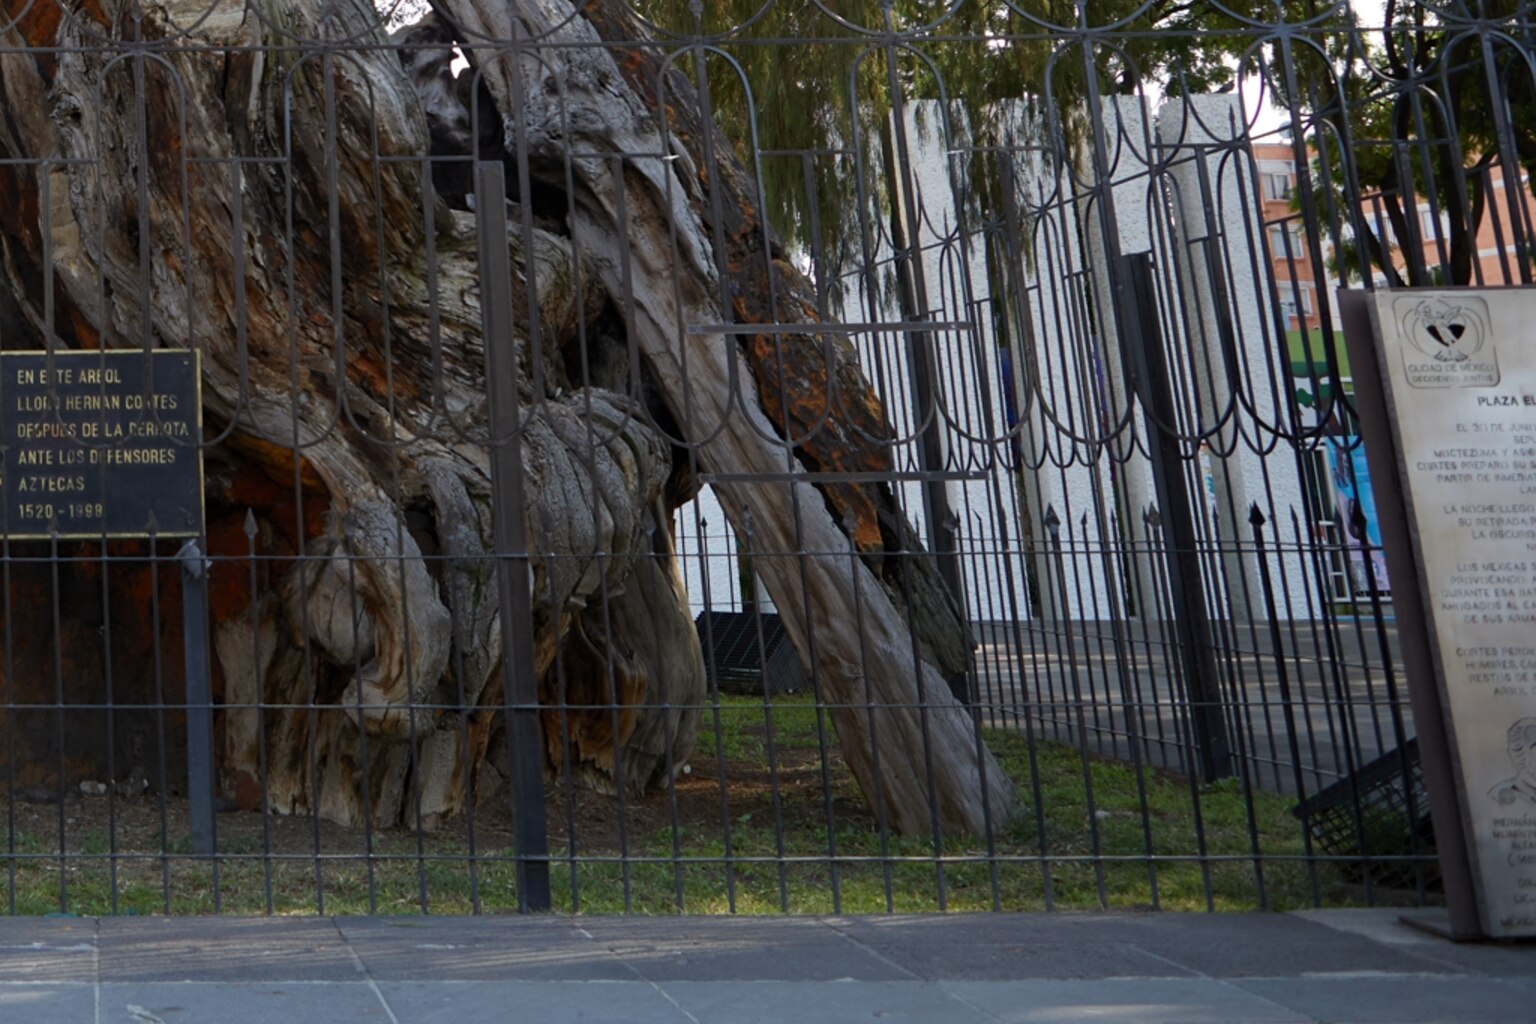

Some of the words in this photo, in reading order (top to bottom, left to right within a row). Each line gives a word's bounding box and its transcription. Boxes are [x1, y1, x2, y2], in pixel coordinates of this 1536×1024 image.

[17, 370, 34, 384] EN
[40, 369, 72, 384] ETE
[66, 395, 120, 410] HERNAN
[1477, 395, 1519, 407] PLAZA
[82, 422, 99, 438] DE
[105, 423, 123, 437] LA
[1456, 423, 1468, 432] EL
[18, 450, 53, 465] ANTE
[59, 450, 84, 464] LOS
[18, 477, 85, 492] AZTECAS
[18, 504, 54, 519] 1520
[1443, 504, 1457, 514] LA
[1461, 504, 1496, 514] NOCHE
[1472, 530, 1485, 540] LA
